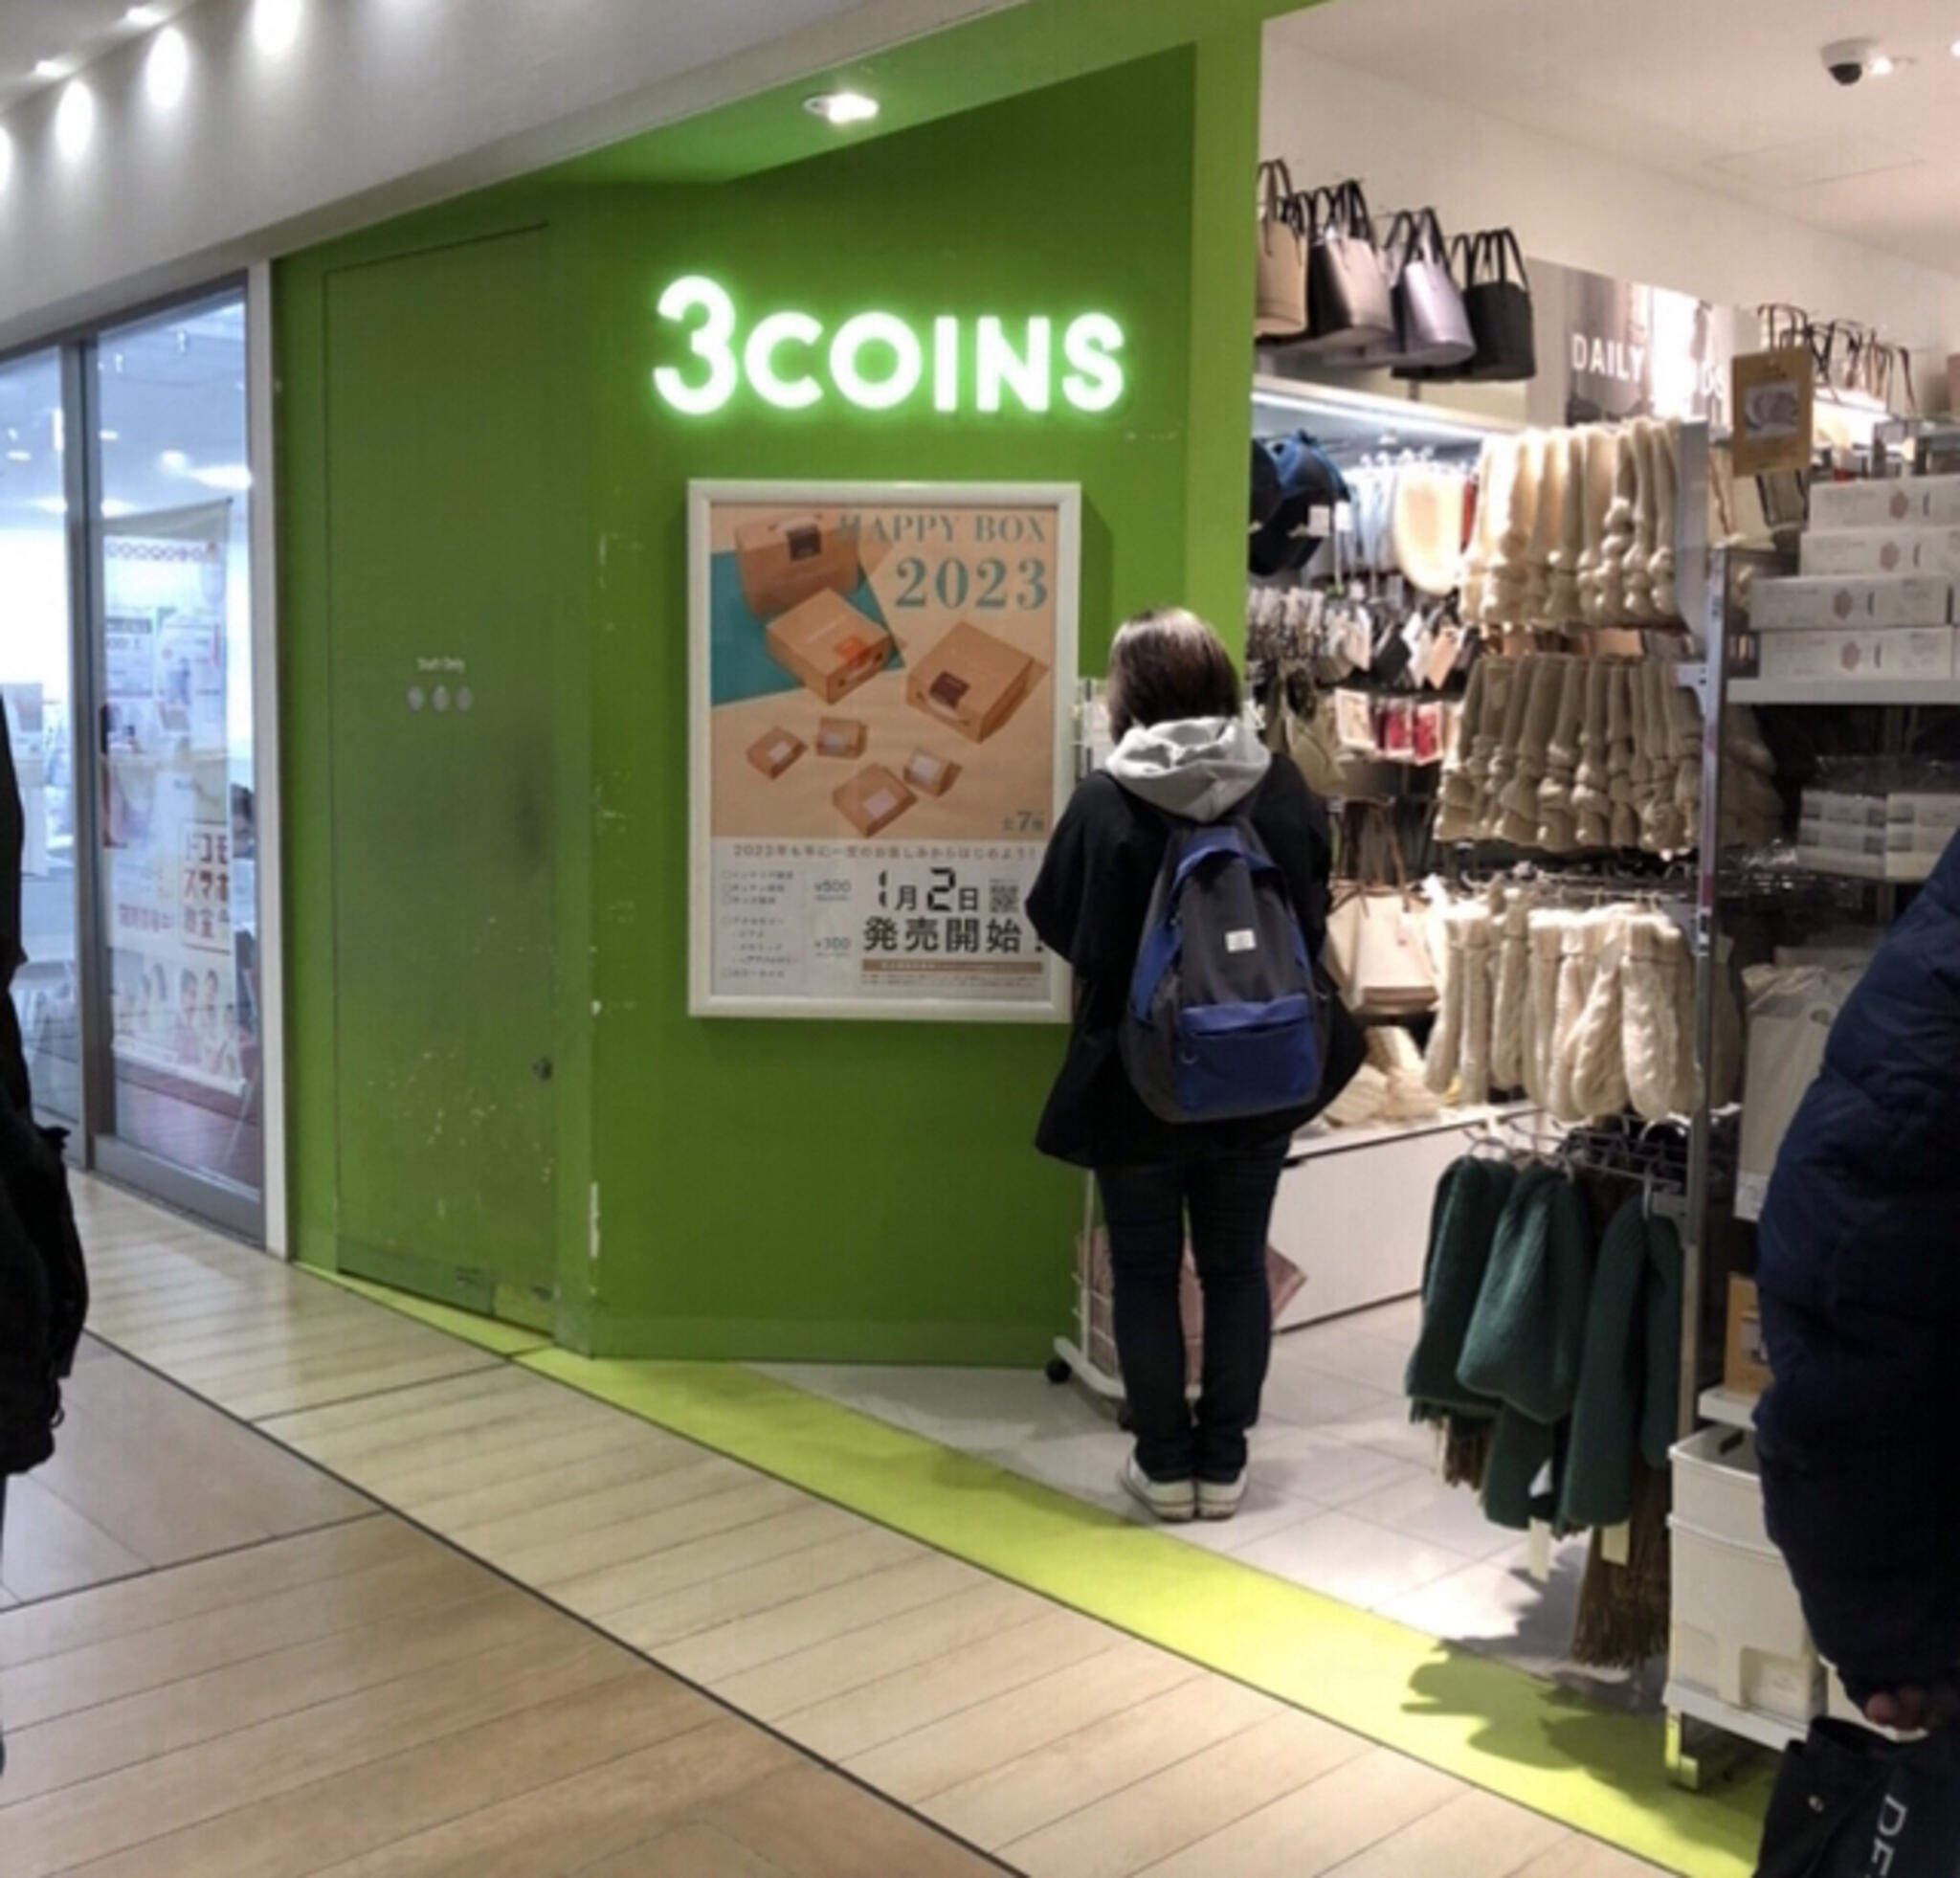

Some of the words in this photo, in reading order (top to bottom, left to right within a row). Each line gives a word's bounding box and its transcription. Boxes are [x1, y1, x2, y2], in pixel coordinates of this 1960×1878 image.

[654, 275, 1125, 415] 3COINS
[1571, 333, 1645, 382] DAILY
[839, 513, 956, 543] HAPPY
[974, 514, 1047, 543] BOX
[895, 556, 1048, 610] 2023
[863, 915, 1044, 953] 発売開始
